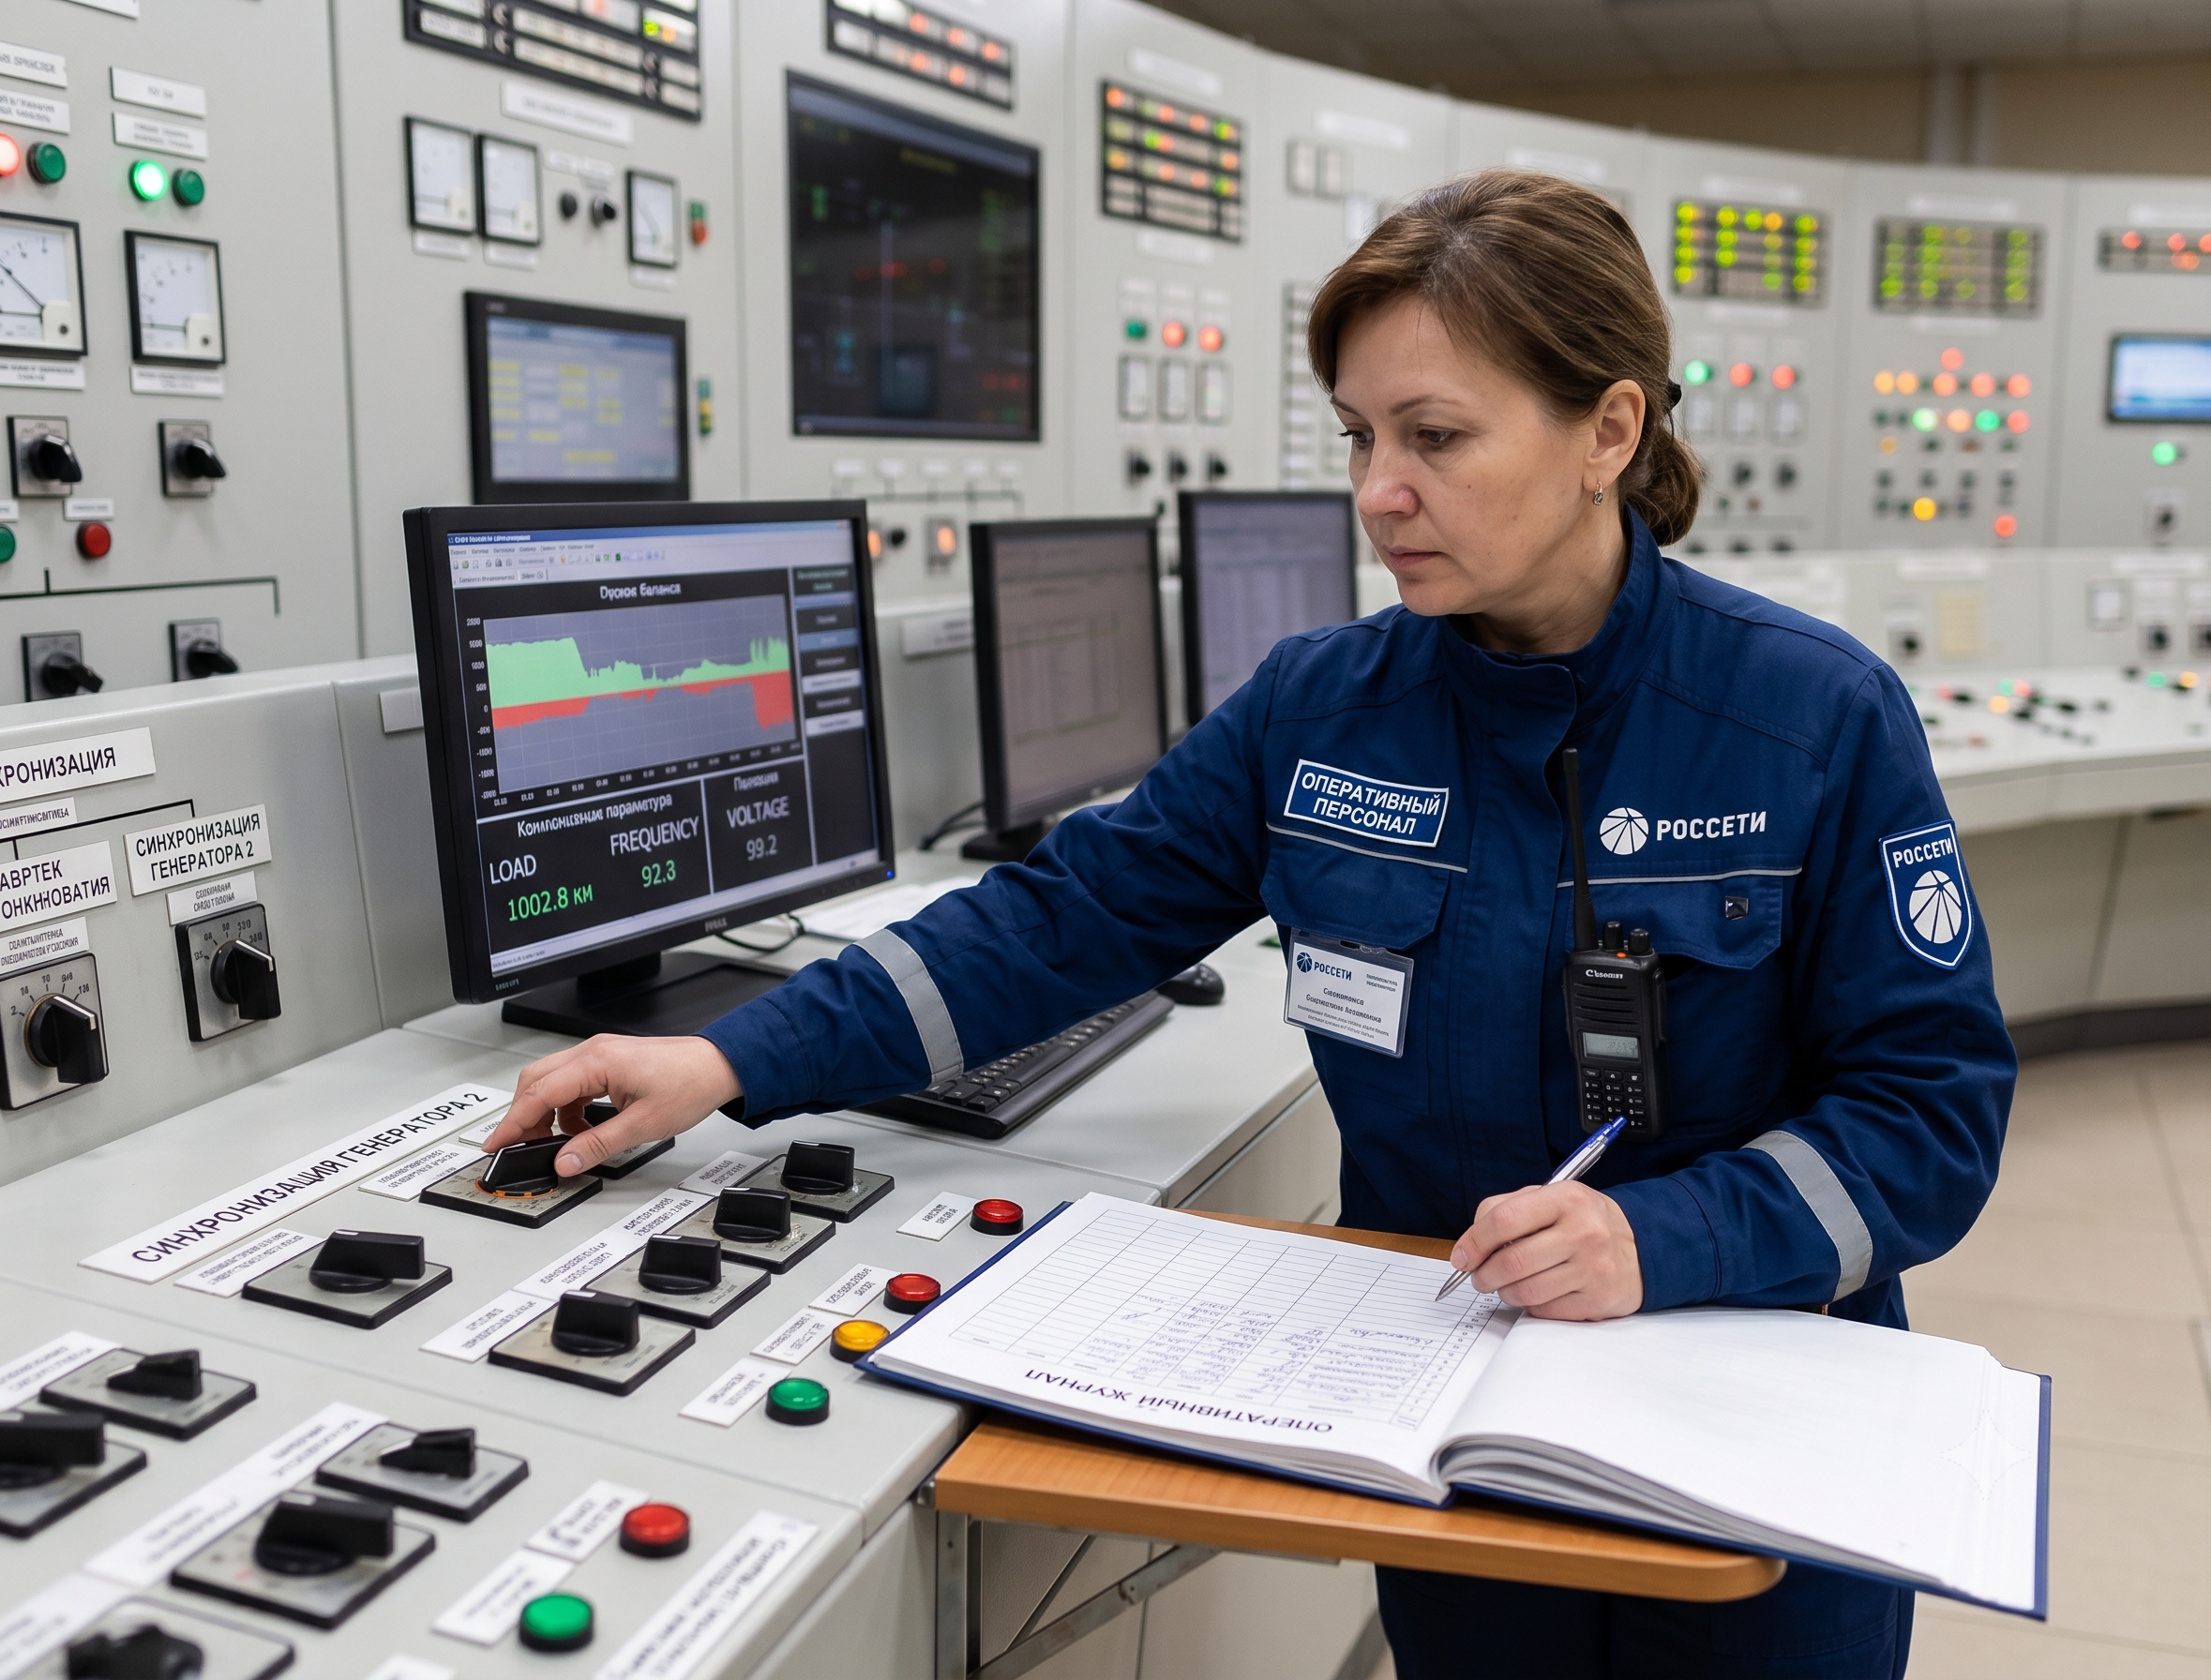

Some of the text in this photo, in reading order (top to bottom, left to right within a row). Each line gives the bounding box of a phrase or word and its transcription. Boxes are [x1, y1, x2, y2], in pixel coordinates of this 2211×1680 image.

[1301, 772, 1441, 816] ОПЕРАТИВНЫЙ
[727, 796, 790, 829] VOLTAGE
[1313, 797, 1417, 835] ПЕРСОНАЛ
[1656, 811, 1767, 841] РОССЕТИ
[136, 813, 261, 857] СИНХРОНИЗАЦИЯ
[609, 816, 699, 856] FREQUENCY
[745, 833, 778, 862] 99.2
[1892, 837, 1954, 868] РОССЕТИ
[150, 840, 254, 882] ГЕНЕРАТОРА 2
[489, 854, 537, 885] LOAD
[641, 860, 677, 888] 92.3
[507, 886, 568, 922] 1002.8
[1314, 961, 1352, 982] РОССЕТИ
[131, 1159, 344, 1264] СИНХРОНИЗАЦИЯ
[336, 1102, 472, 1169] ГЕНЕРАТОРА
[463, 1092, 489, 1103] 2
[1024, 1368, 1333, 1432] ОПЕРАТИВНЫЙ ЖУРНАЛ
